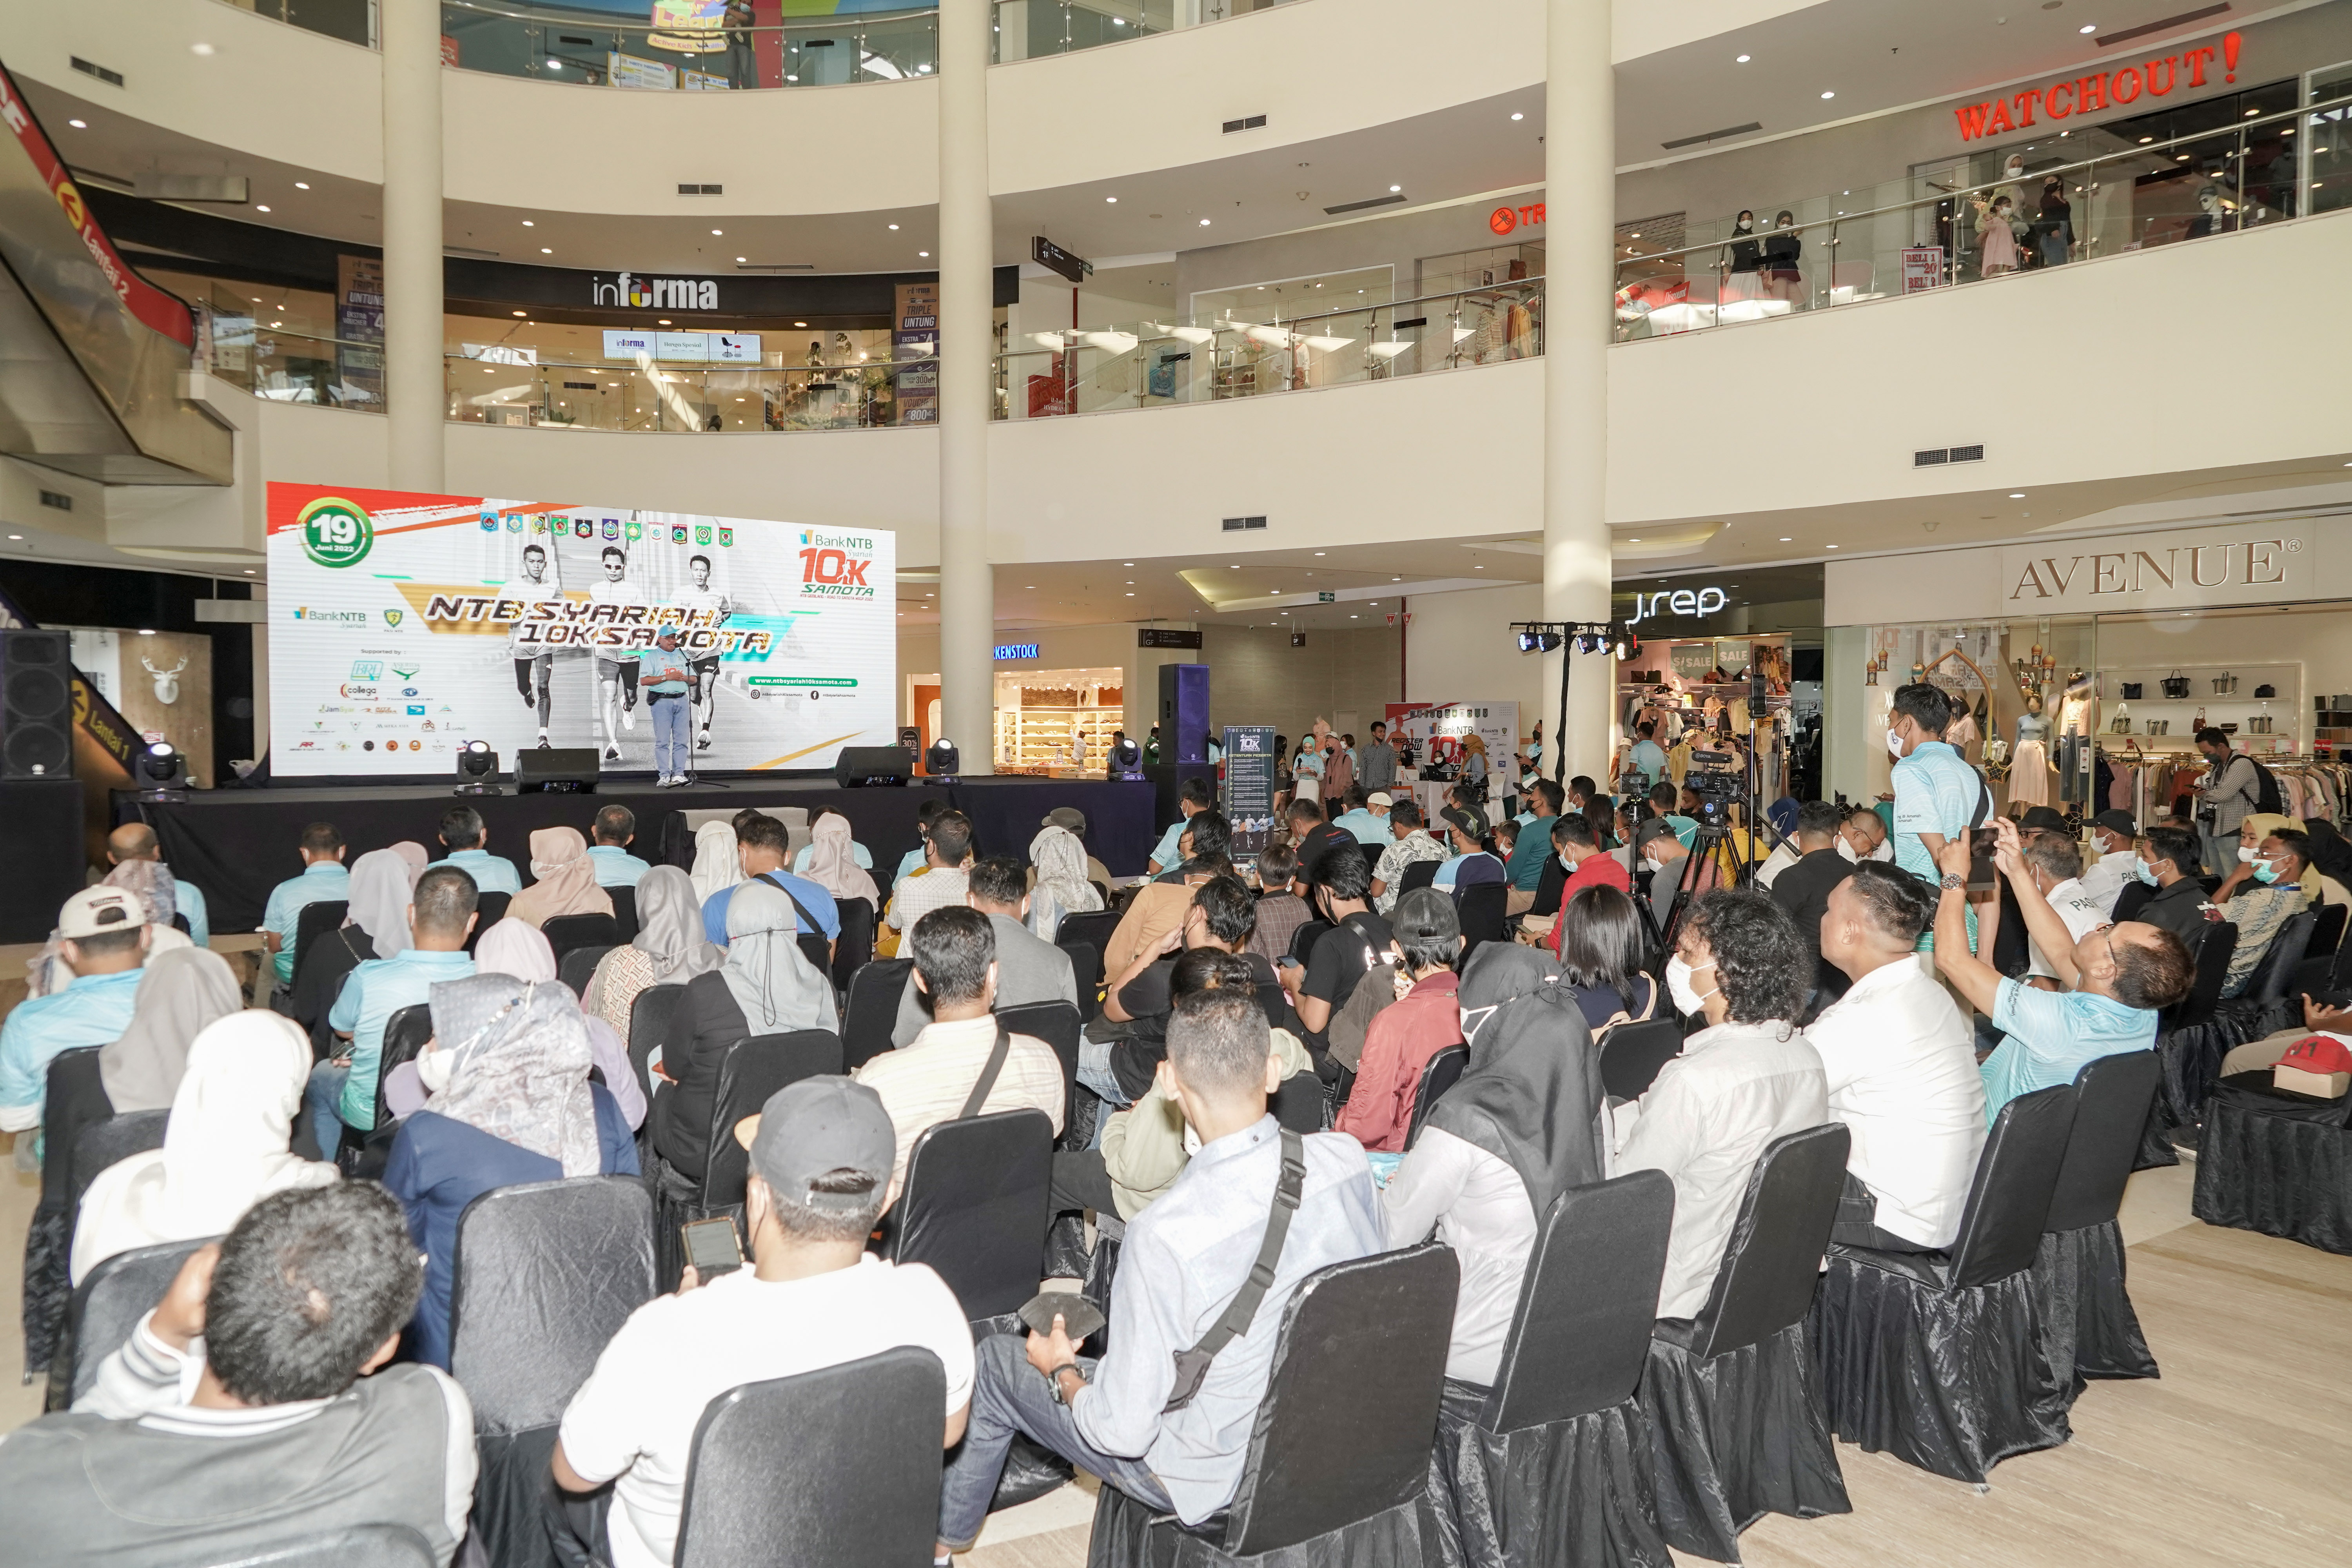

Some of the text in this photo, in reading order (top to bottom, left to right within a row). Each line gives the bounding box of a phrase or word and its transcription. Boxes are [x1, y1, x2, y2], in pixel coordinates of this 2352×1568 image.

[652, 37, 675, 47] Active
[1955, 32, 2242, 141] WATCHOUT!
[1043, 250, 1049, 259] 1F
[1906, 254, 1928, 262] BELI
[82, 224, 130, 302] Lantai 2
[1908, 277, 1929, 289] BELI
[593, 272, 718, 310] informa
[1664, 286, 1687, 303] Discount
[907, 305, 931, 315] TRIPLE
[904, 317, 935, 327] UNTUNG
[617, 339, 644, 347] informa
[910, 410, 927, 420] 800
[312, 514, 357, 544] 19
[816, 535, 873, 549] BankNTB
[847, 550, 873, 559] Syariah
[799, 548, 872, 586] 10K
[801, 584, 874, 596] SAMOTA
[1625, 587, 1725, 625] j.rep
[309, 611, 366, 622] BankNTB
[994, 644, 1038, 660] KENSTOCK
[1719, 650, 1748, 662] SALE
[1686, 657, 1711, 668] SALE
[348, 686, 376, 696] collega
[89, 710, 130, 760] Lantai 1
[1438, 726, 1473, 734] BankNTB
[1240, 739, 1260, 748] 10K
